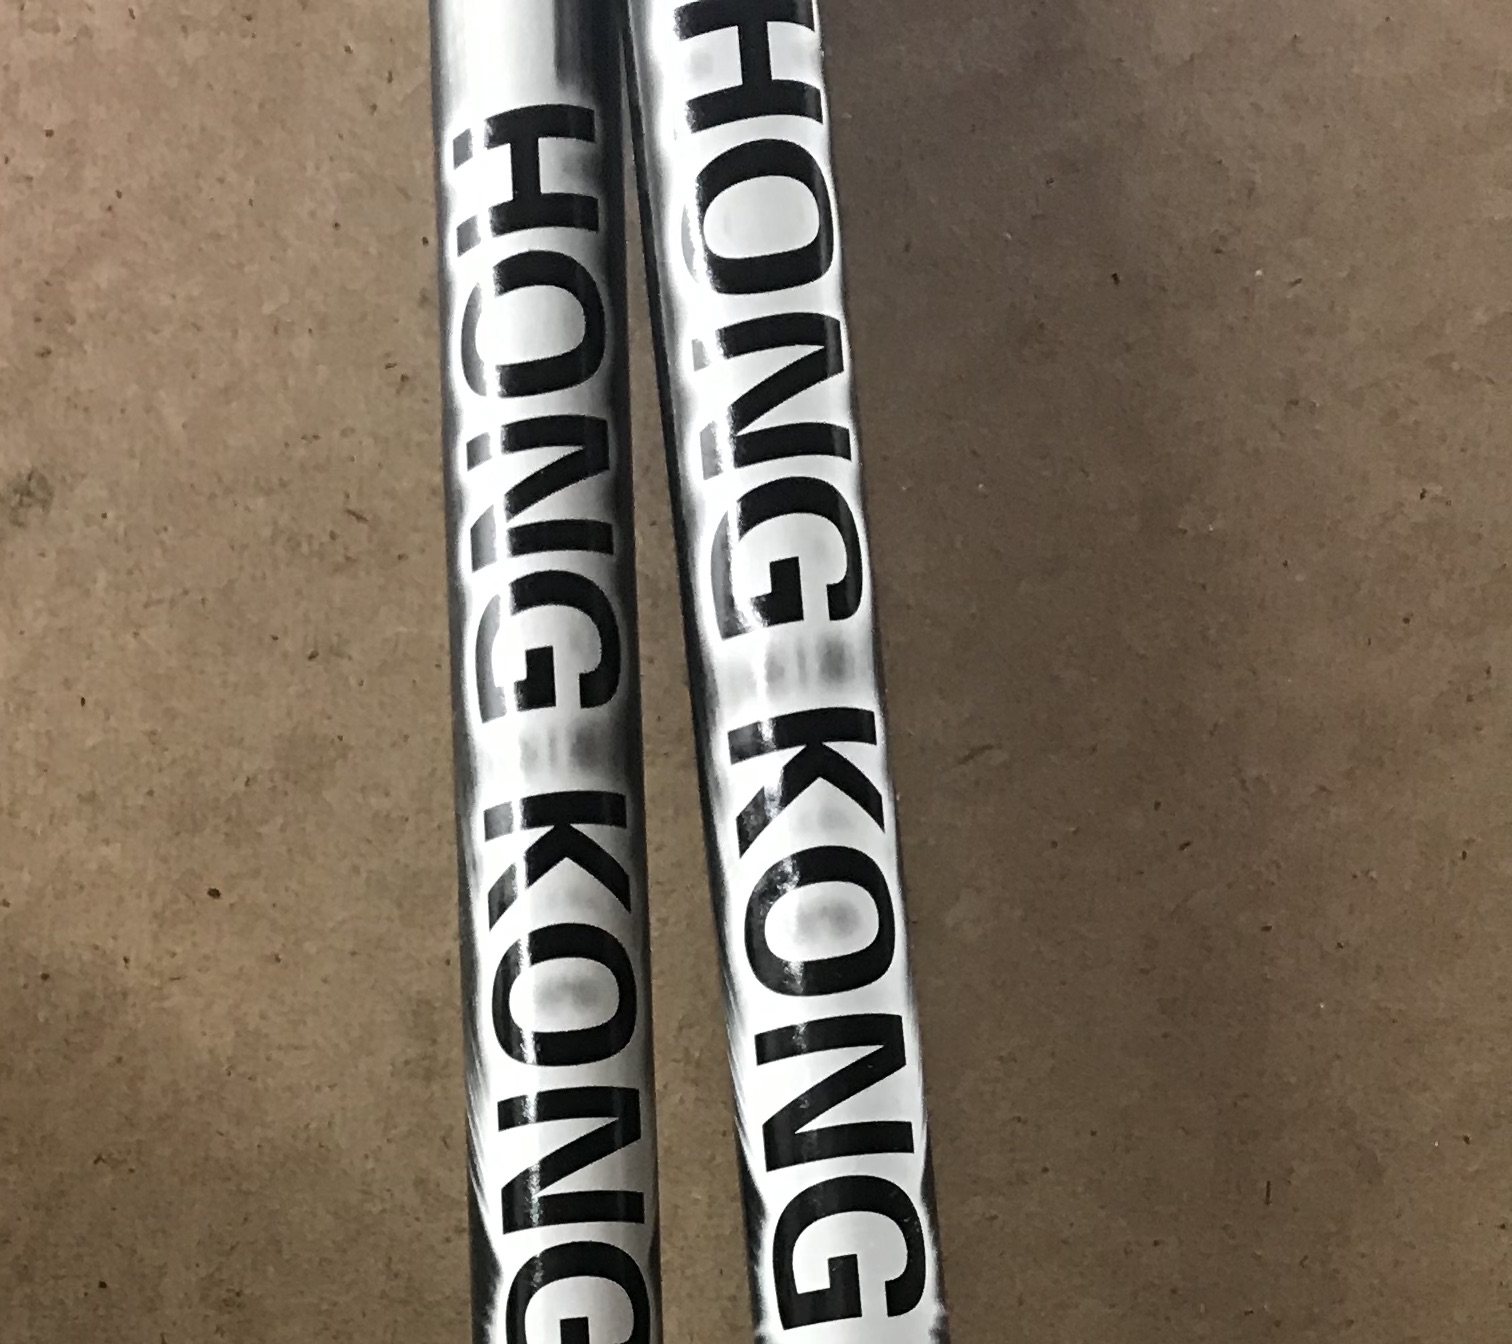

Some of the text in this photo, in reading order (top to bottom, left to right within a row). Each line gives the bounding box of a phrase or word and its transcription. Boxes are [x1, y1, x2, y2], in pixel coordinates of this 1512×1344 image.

[453, 103, 622, 723] HONG
[674, 0, 863, 641] HONG
[727, 705, 926, 1331] KONG
